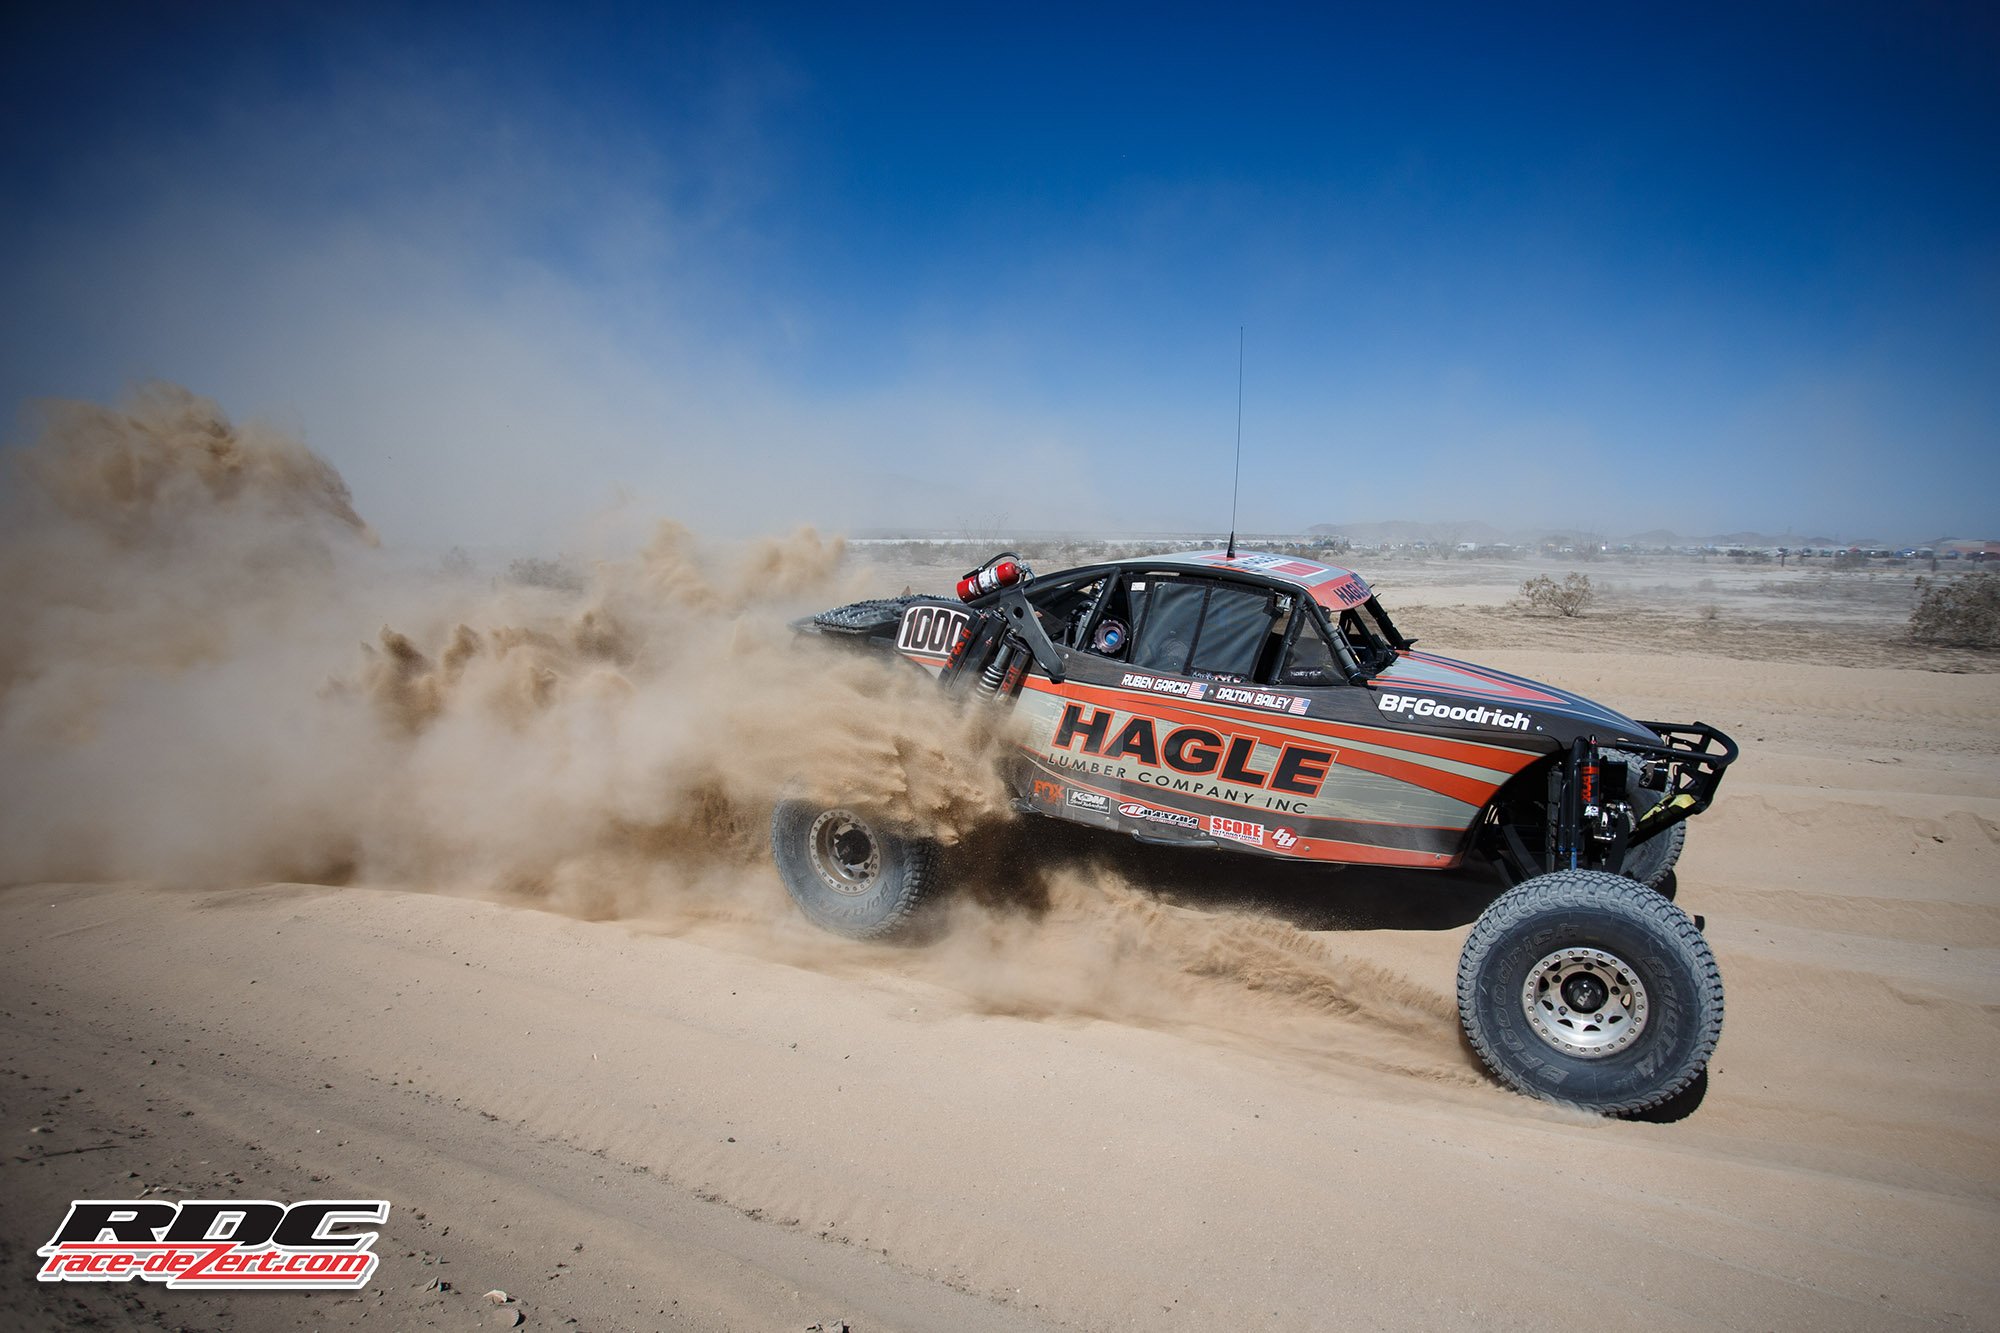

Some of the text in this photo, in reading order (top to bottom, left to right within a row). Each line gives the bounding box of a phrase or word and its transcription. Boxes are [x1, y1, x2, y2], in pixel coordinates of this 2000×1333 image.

[903, 608, 969, 652] 1000
[1121, 673, 1190, 696] RUBEN GARCIA
[1216, 687, 1290, 710] DALTON BAILEY
[1378, 693, 1530, 731] BFGoodrich
[1052, 702, 1338, 798] HAGLE
[1049, 752, 1308, 814] LUMBER COMPANY INC
[1213, 818, 1261, 838] SCORE
